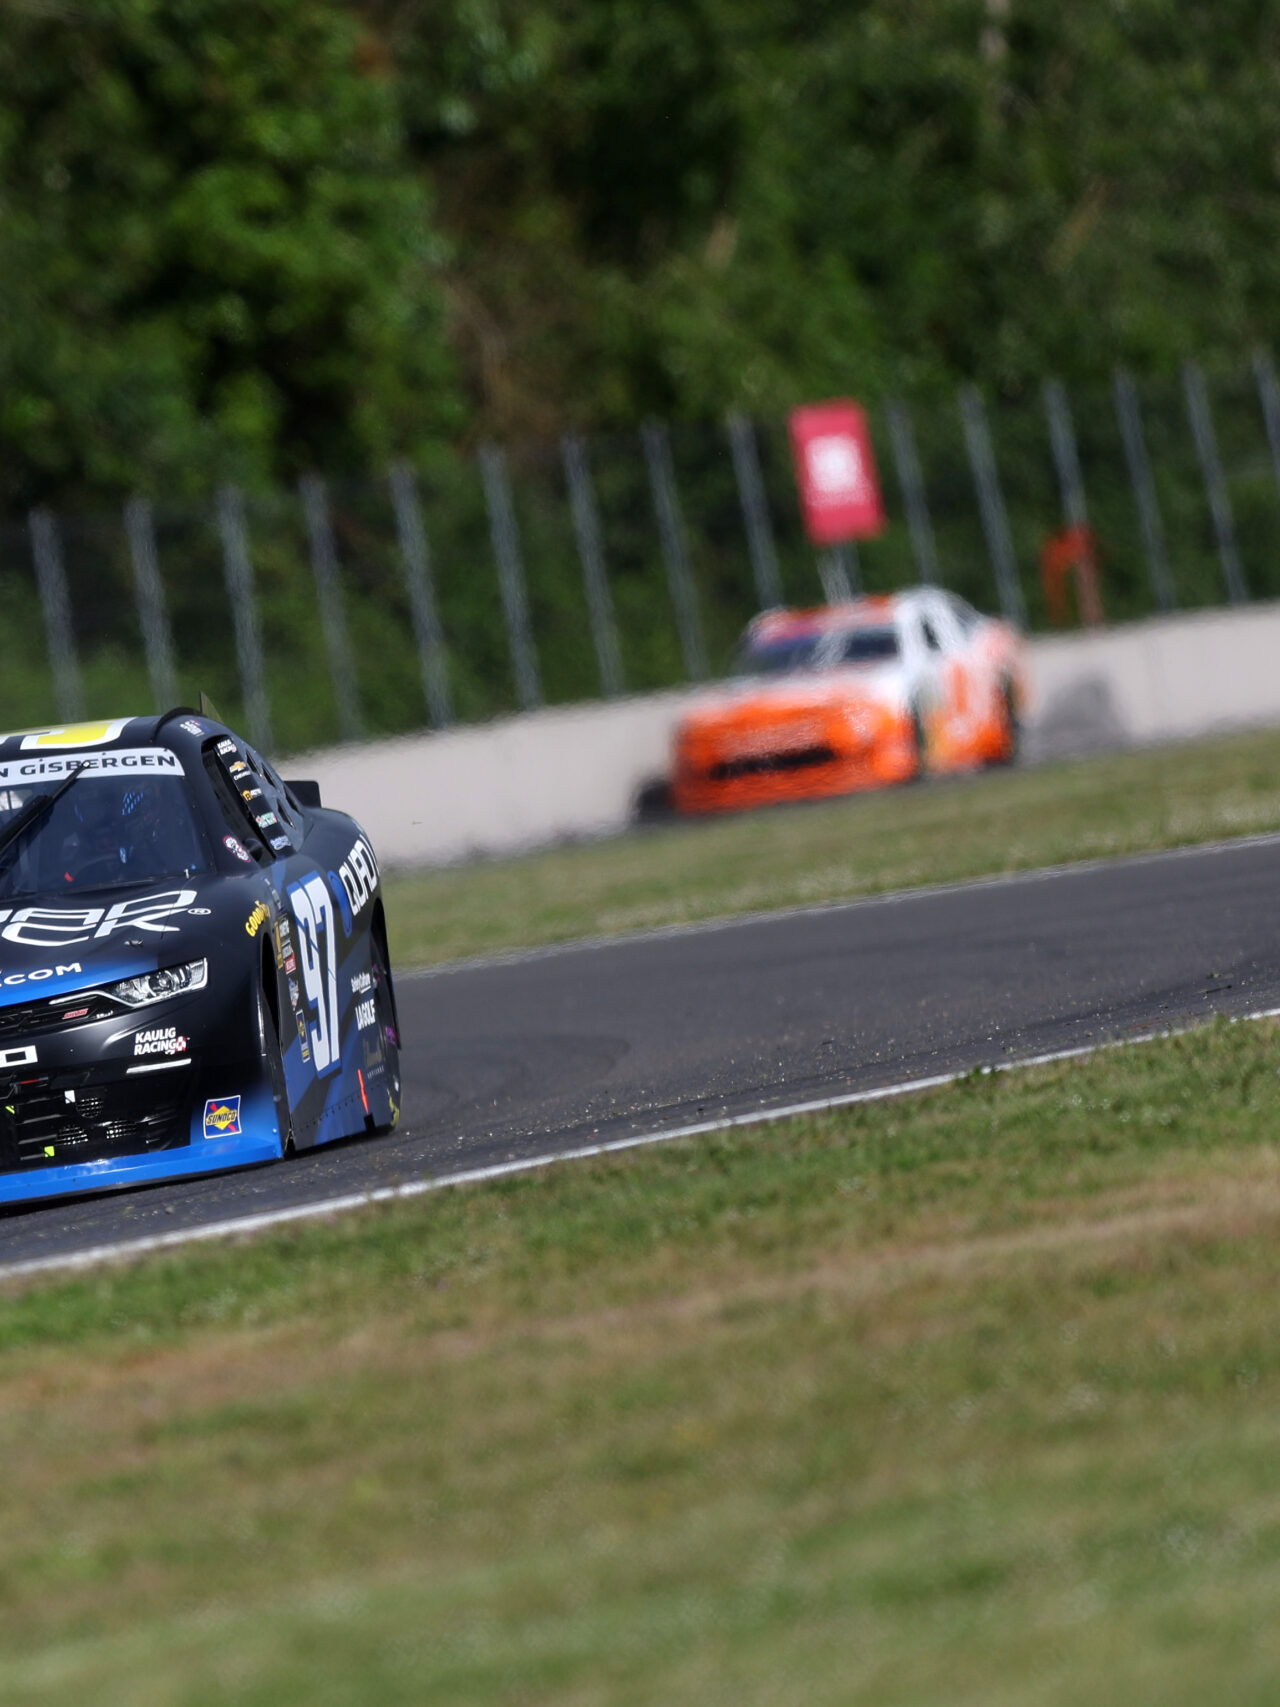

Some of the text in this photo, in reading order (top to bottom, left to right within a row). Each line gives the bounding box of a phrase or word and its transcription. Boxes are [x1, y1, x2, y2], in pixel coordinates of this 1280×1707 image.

[20, 754, 176, 776] GISBERGEN
[290, 876, 340, 1072] 97
[135, 1027, 176, 1044] KAULIG
[134, 1038, 177, 1055] RACING
[205, 1110, 238, 1126] SUNOCO
